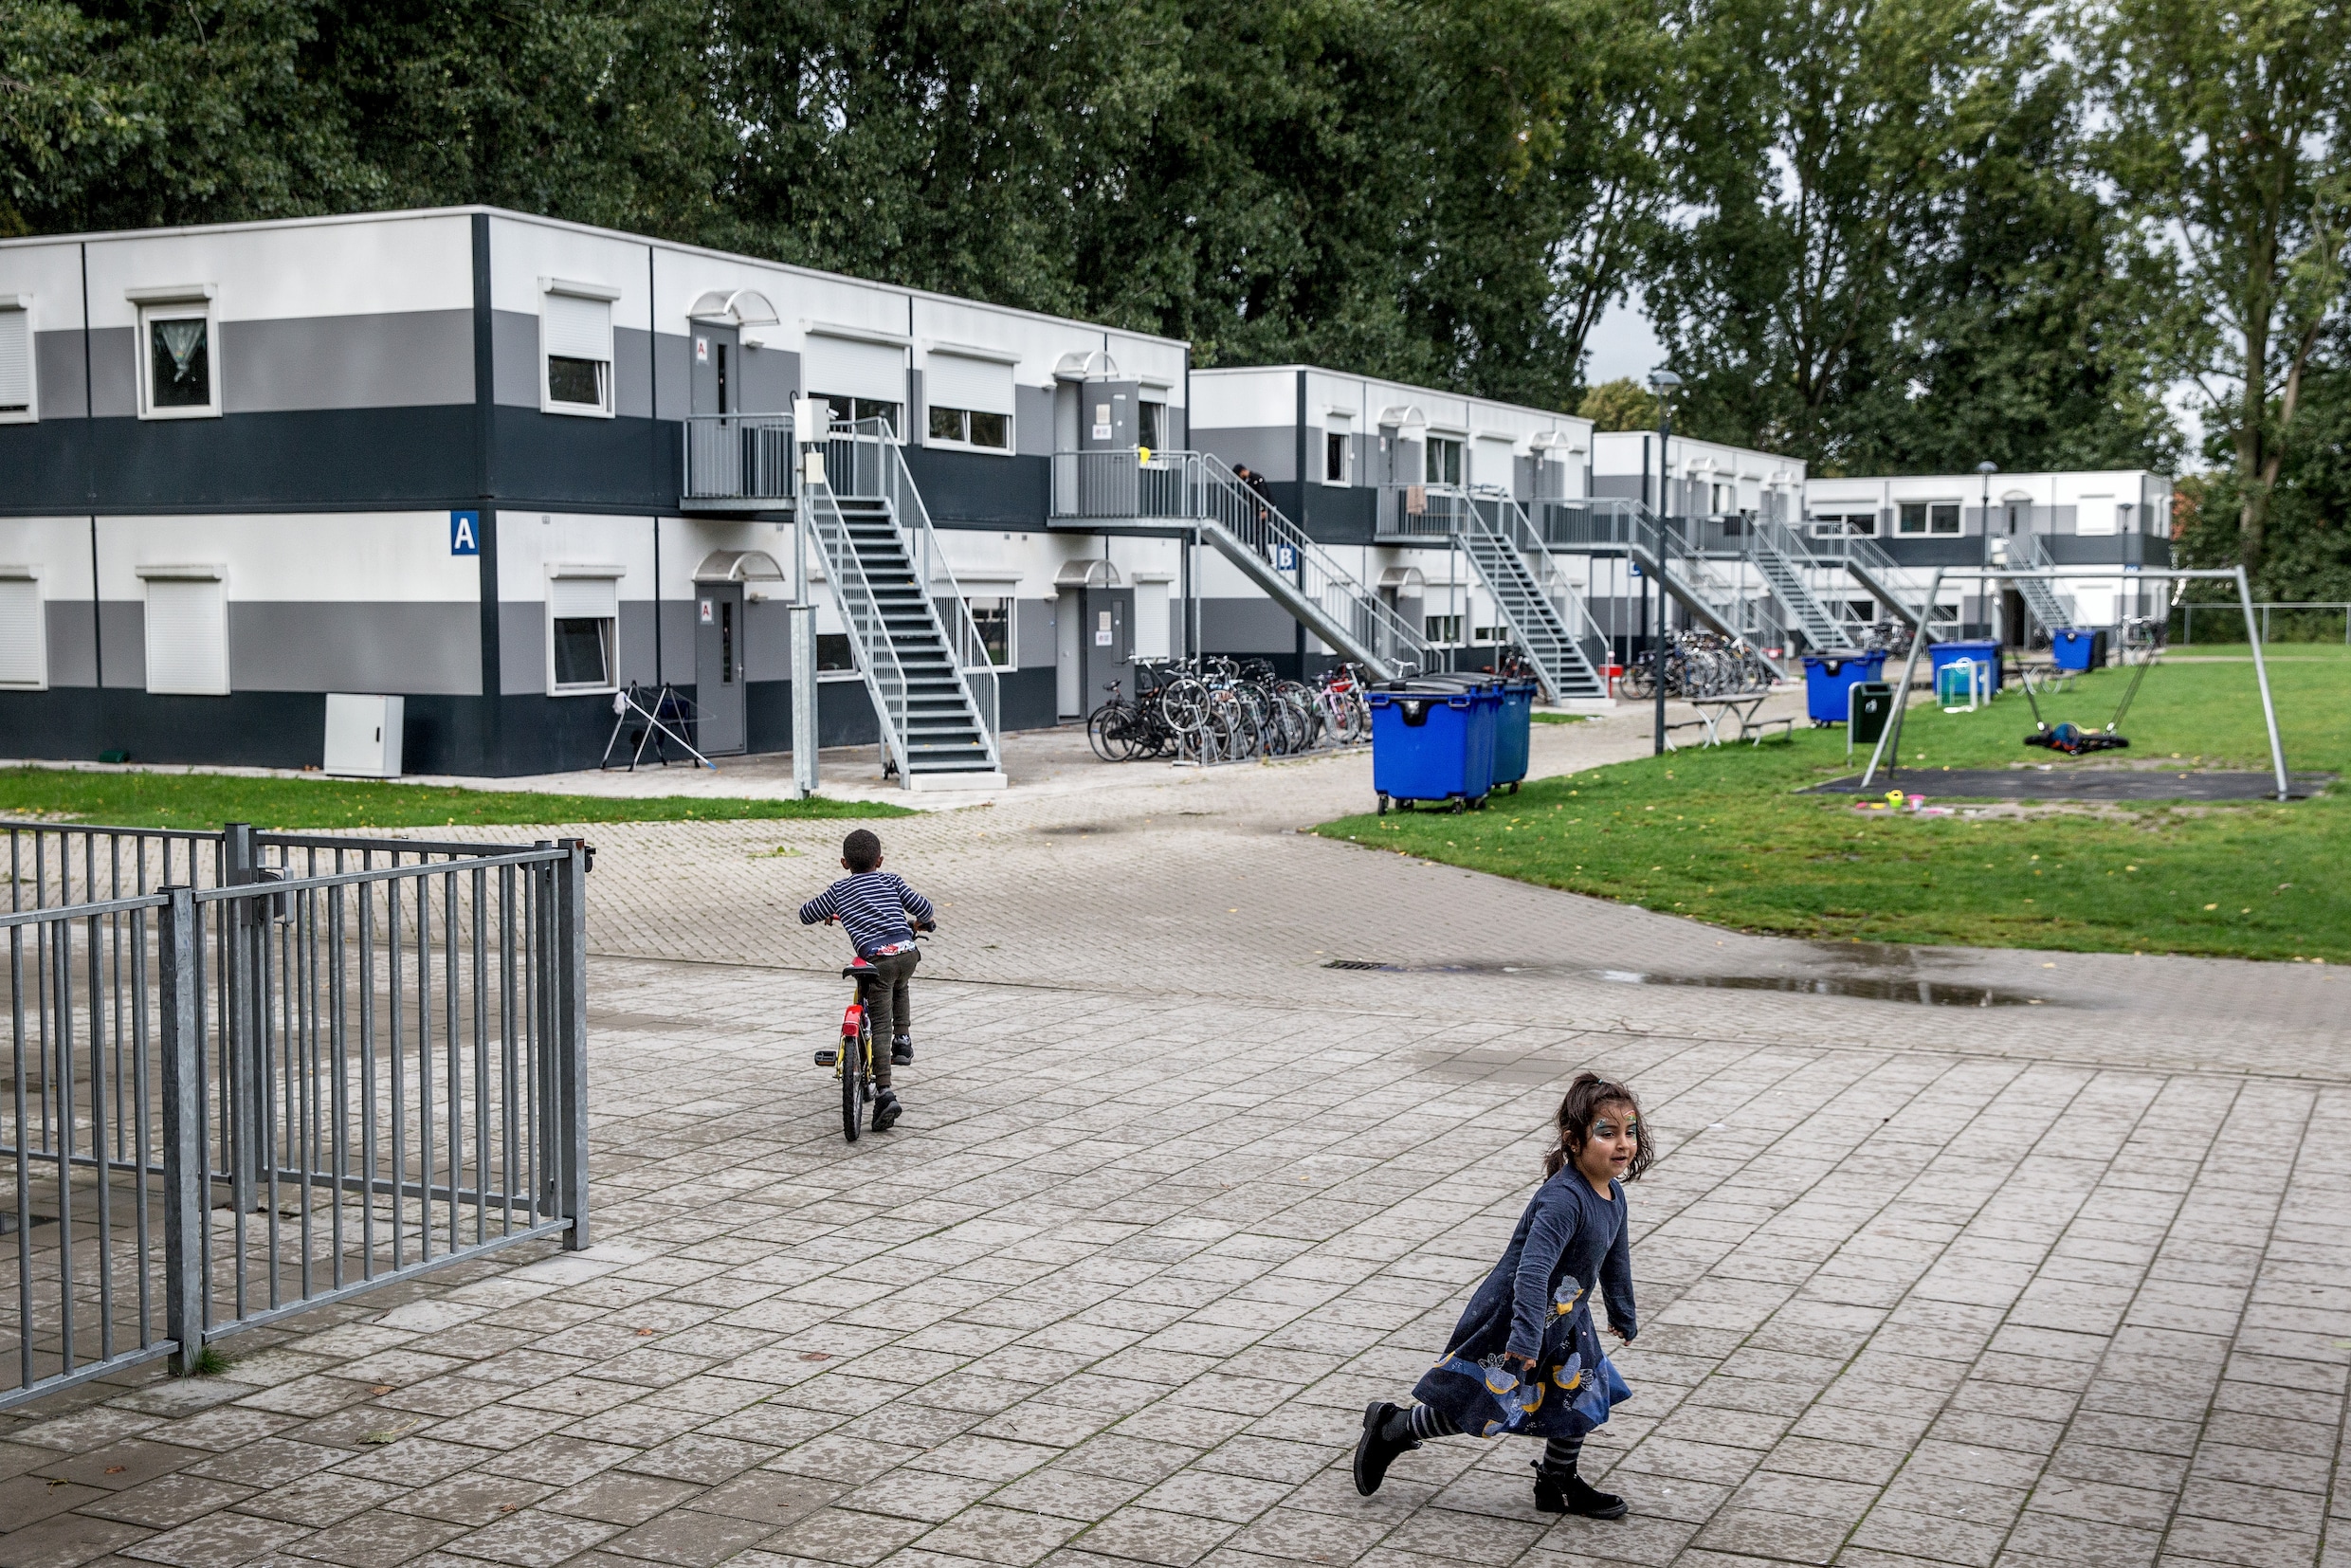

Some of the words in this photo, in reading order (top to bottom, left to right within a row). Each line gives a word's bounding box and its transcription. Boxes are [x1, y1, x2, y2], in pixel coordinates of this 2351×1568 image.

[698, 342, 705, 355] A
[454, 517, 476, 550] A
[1280, 547, 1293, 568] B
[702, 604, 710, 616] A
